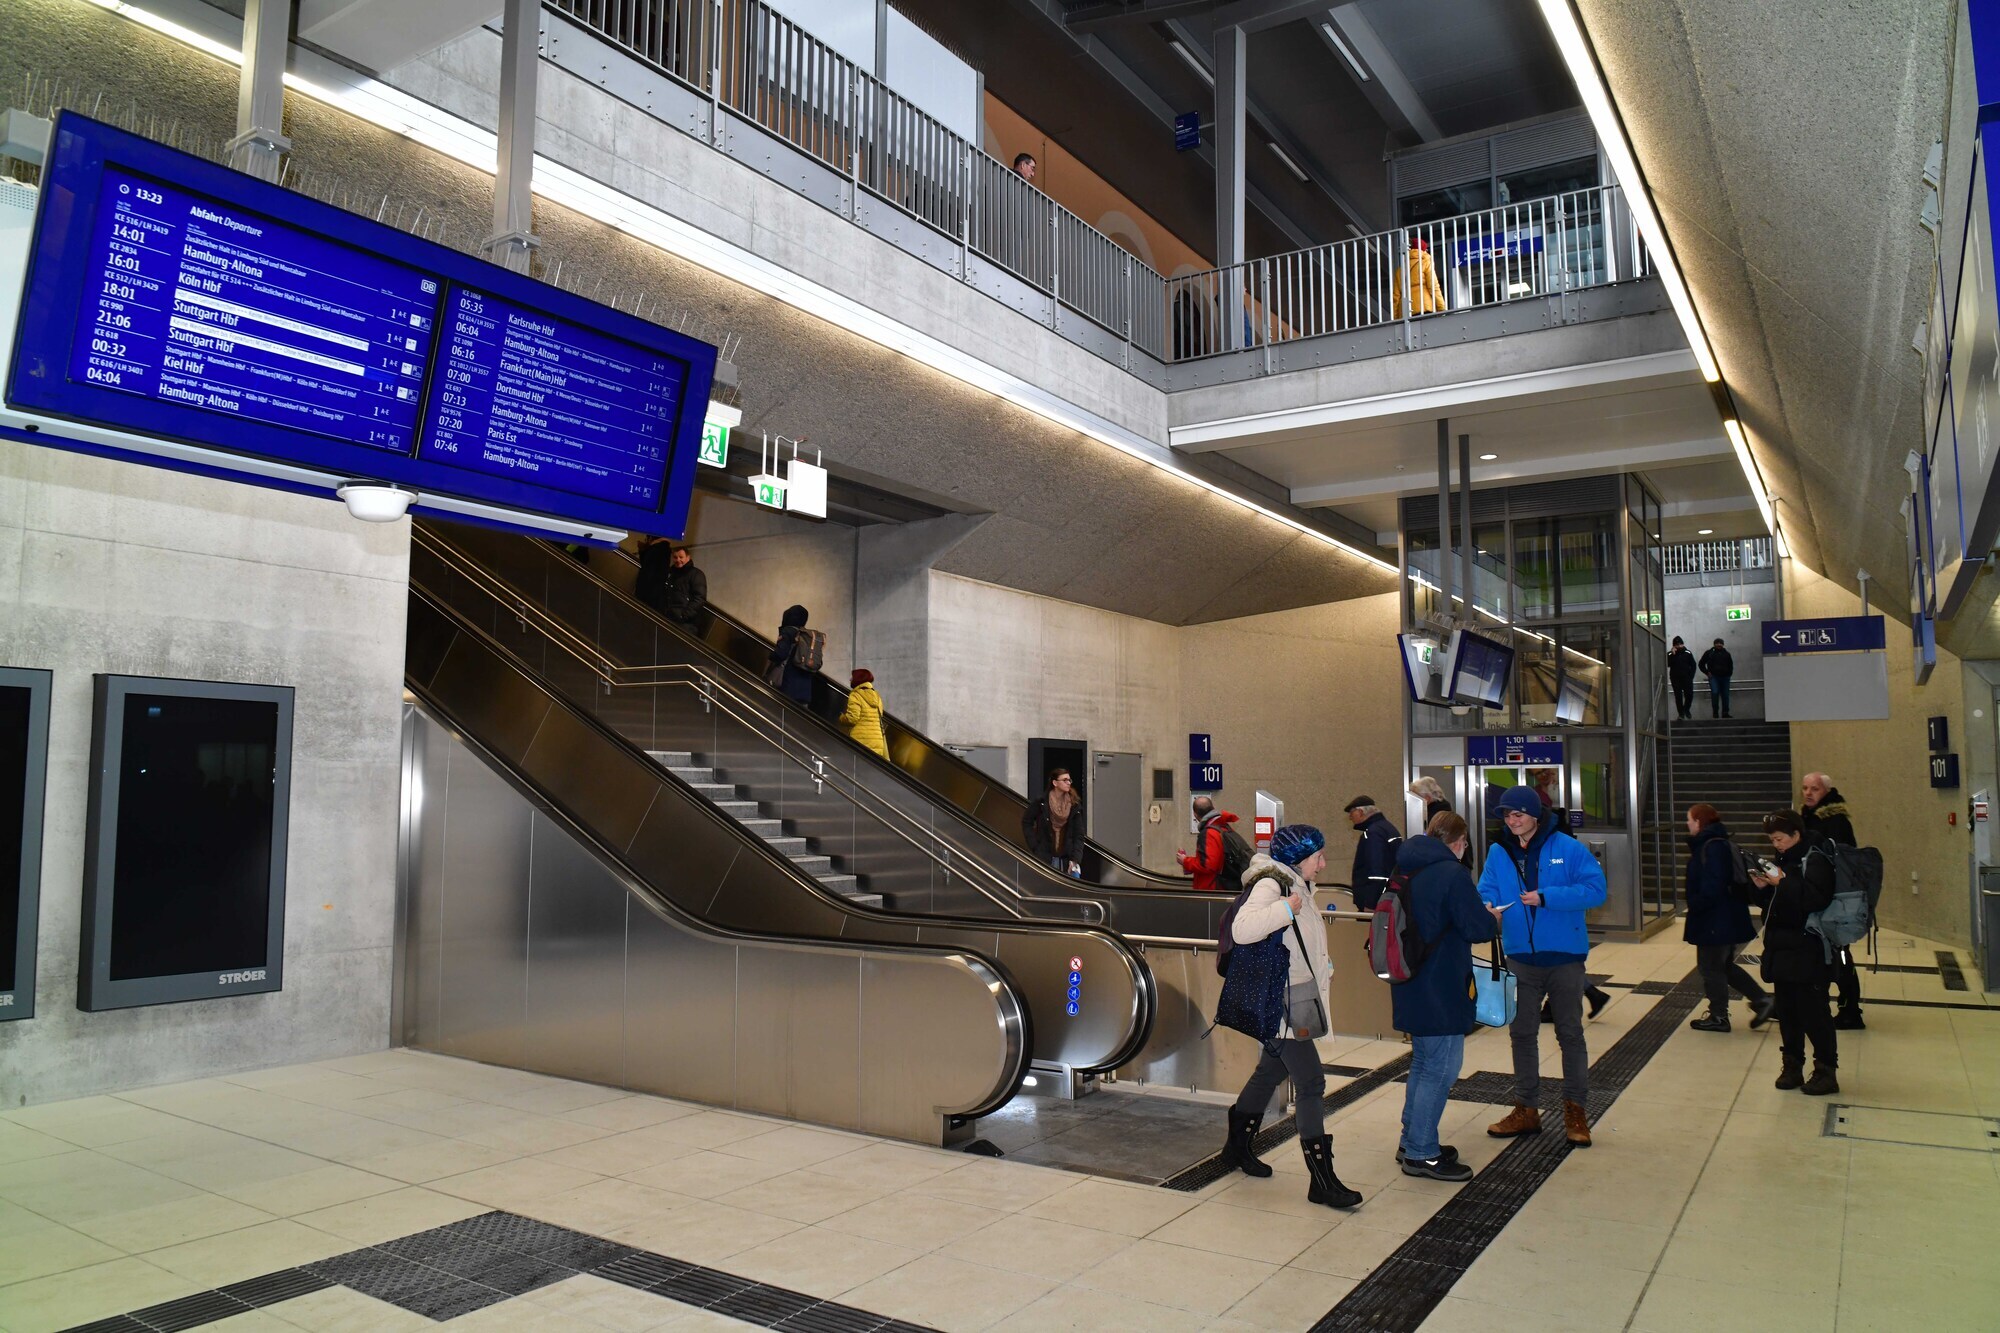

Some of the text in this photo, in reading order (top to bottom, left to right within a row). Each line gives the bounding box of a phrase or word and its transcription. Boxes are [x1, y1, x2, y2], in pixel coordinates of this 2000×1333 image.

[136, 188, 163, 205] 13:23
[114, 213, 126, 222] ICE
[152, 224, 169, 235] 3419
[190, 206, 224, 225] Abfahrt
[223, 217, 263, 237] Departure
[113, 224, 145, 244] 14:01
[109, 242, 138, 256] ICE 2834
[185, 234, 219, 250] Zusätzlicher
[218, 244, 231, 254] Halt
[236, 250, 259, 264] Limburg
[258, 257, 270, 266] Süd
[279, 263, 307, 278] Montabaur
[108, 252, 140, 272] 16:01
[183, 244, 263, 278] Hamburg-Altona
[104, 270, 116, 280] ICE
[142, 280, 159, 291] 3429
[178, 271, 222, 294] Köln Hbf
[103, 281, 135, 300] 18:01
[180, 261, 211, 277] Ersatzfahrt
[211, 271, 220, 279] für
[220, 273, 230, 282] ICE
[230, 276, 242, 285] 514
[253, 283, 284, 298] Zusätzlicher
[284, 293, 296, 302] Halt
[300, 297, 322, 311] Limburg
[321, 303, 331, 312] Süd
[340, 309, 366, 322] Montabaur
[99, 299, 124, 312] ICE 990
[173, 299, 219, 322] Stuttgart
[220, 312, 240, 327] Hbf
[391, 308, 396, 319] 1
[460, 298, 484, 314] 05:35
[97, 309, 131, 329] 21:06
[508, 313, 555, 337] Karlsruhe Hbf
[94, 328, 119, 340] ICE 618
[456, 321, 479, 337] 06:04
[168, 327, 235, 354] Stuttgart Hbf
[387, 333, 392, 344] 1
[92, 338, 126, 357] 00:32
[451, 345, 475, 360] 06:16
[504, 336, 560, 362] Hamburg-Altona
[89, 356, 100, 366] ICE
[127, 365, 143, 375] 3401
[163, 355, 205, 375] Kiel Hbf
[165, 345, 192, 358] Stuttgart
[191, 352, 203, 360] Hbf
[207, 355, 236, 368] Mannheim
[235, 363, 246, 371] Hbf
[250, 366, 293, 382] Frankfurt(M)Hbf
[296, 378, 309, 386] Köln
[308, 381, 318, 389] Hbf
[322, 384, 348, 396] Düsseldorf
[382, 357, 387, 368] 1
[652, 362, 657, 371] 1
[87, 367, 121, 385] 04:04
[447, 368, 471, 384] 07:00
[500, 359, 567, 387] Frankfurt(Main)Hbf
[378, 382, 383, 392] 1
[495, 381, 545, 404] Dortmund Hbf
[648, 382, 653, 392] 1
[158, 382, 239, 411] Hamburg-Altona
[160, 372, 187, 385] Stuttgart
[186, 379, 198, 387] Hbf
[202, 383, 231, 395] Mannheim
[230, 389, 241, 397] Hbf
[245, 393, 258, 401] Köln
[272, 399, 299, 411] Düsseldorf
[312, 408, 335, 421] Duisburg
[443, 392, 467, 407] 07:13
[373, 406, 379, 417] 1
[491, 404, 548, 428] Hamburg-Altona
[645, 403, 649, 412] 1
[438, 415, 463, 430] 07:20
[641, 423, 645, 432] 1
[369, 431, 374, 441] 1
[487, 427, 517, 443] Paris Est
[434, 438, 458, 453] 07:46
[637, 444, 642, 453] 1
[483, 450, 539, 472] Hamburg-Altona
[633, 464, 638, 473] 1
[629, 485, 634, 494] 1
[1930, 722, 1935, 740] 1
[1202, 737, 1208, 752] 1
[1505, 736, 1524, 744] 1, 101
[1202, 766, 1220, 782] 101
[1931, 758, 1947, 778] 101
[219, 969, 266, 985] STRÖER
